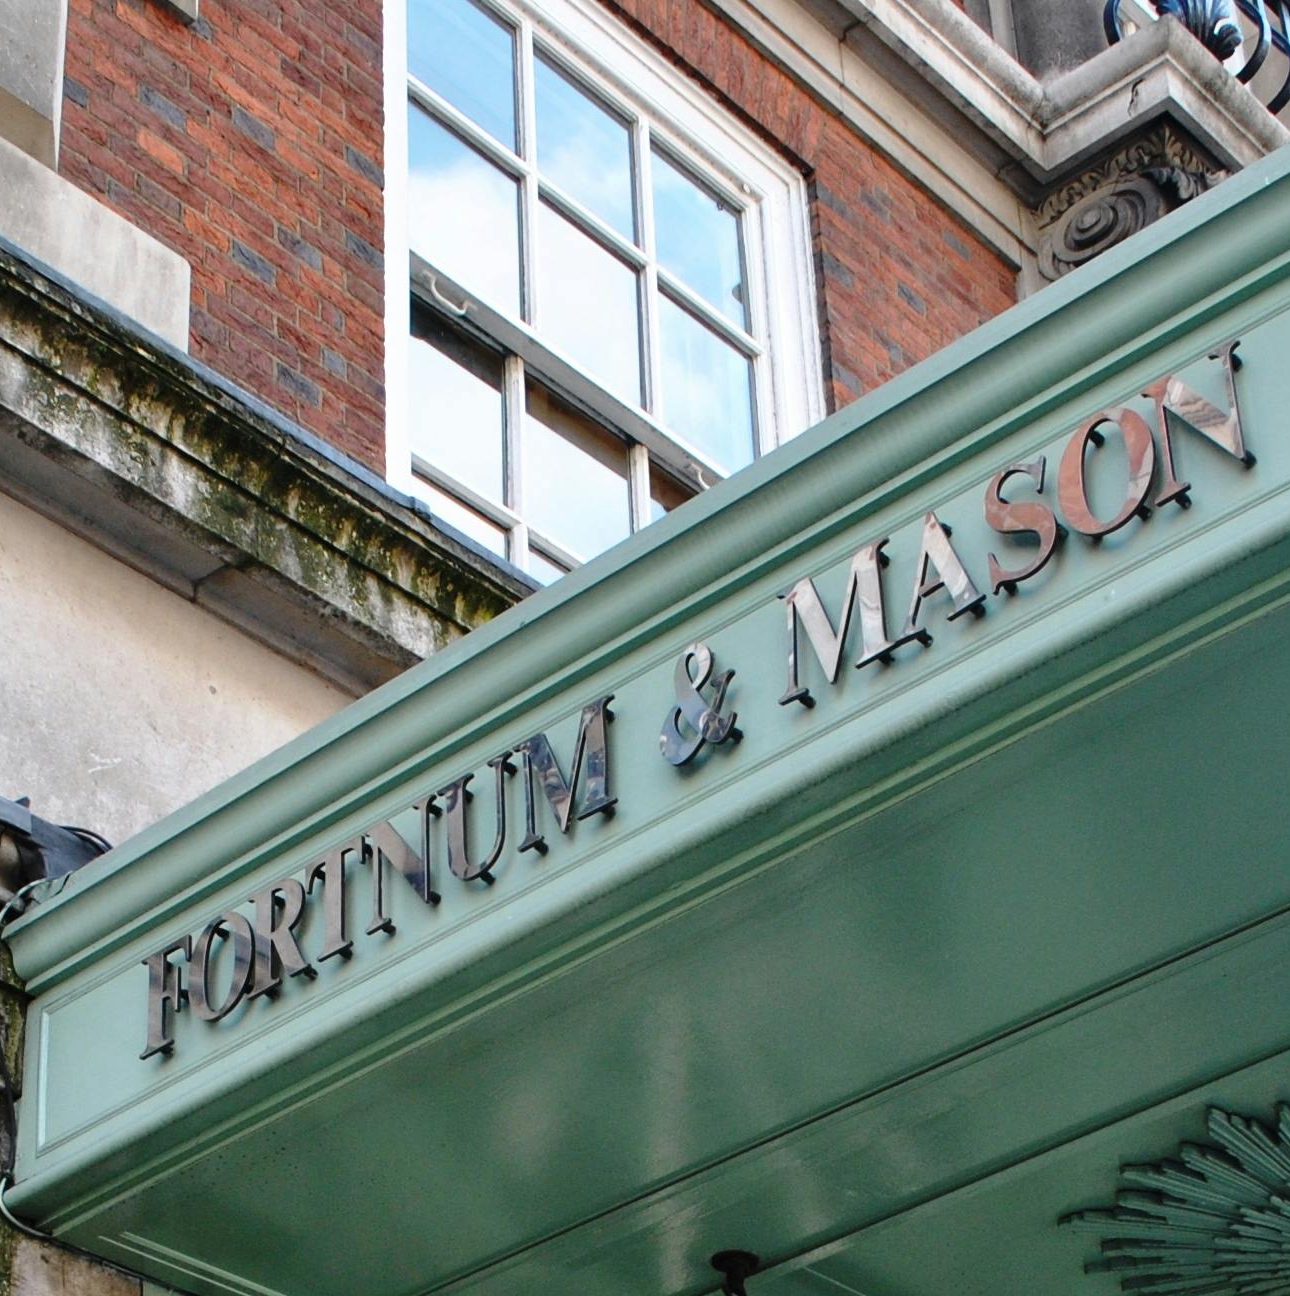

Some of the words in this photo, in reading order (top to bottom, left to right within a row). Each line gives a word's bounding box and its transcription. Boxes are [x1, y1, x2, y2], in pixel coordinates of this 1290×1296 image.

[139, 693, 618, 1060] FORTNUM
[659, 642, 739, 768] &
[776, 339, 1253, 707] MASON
